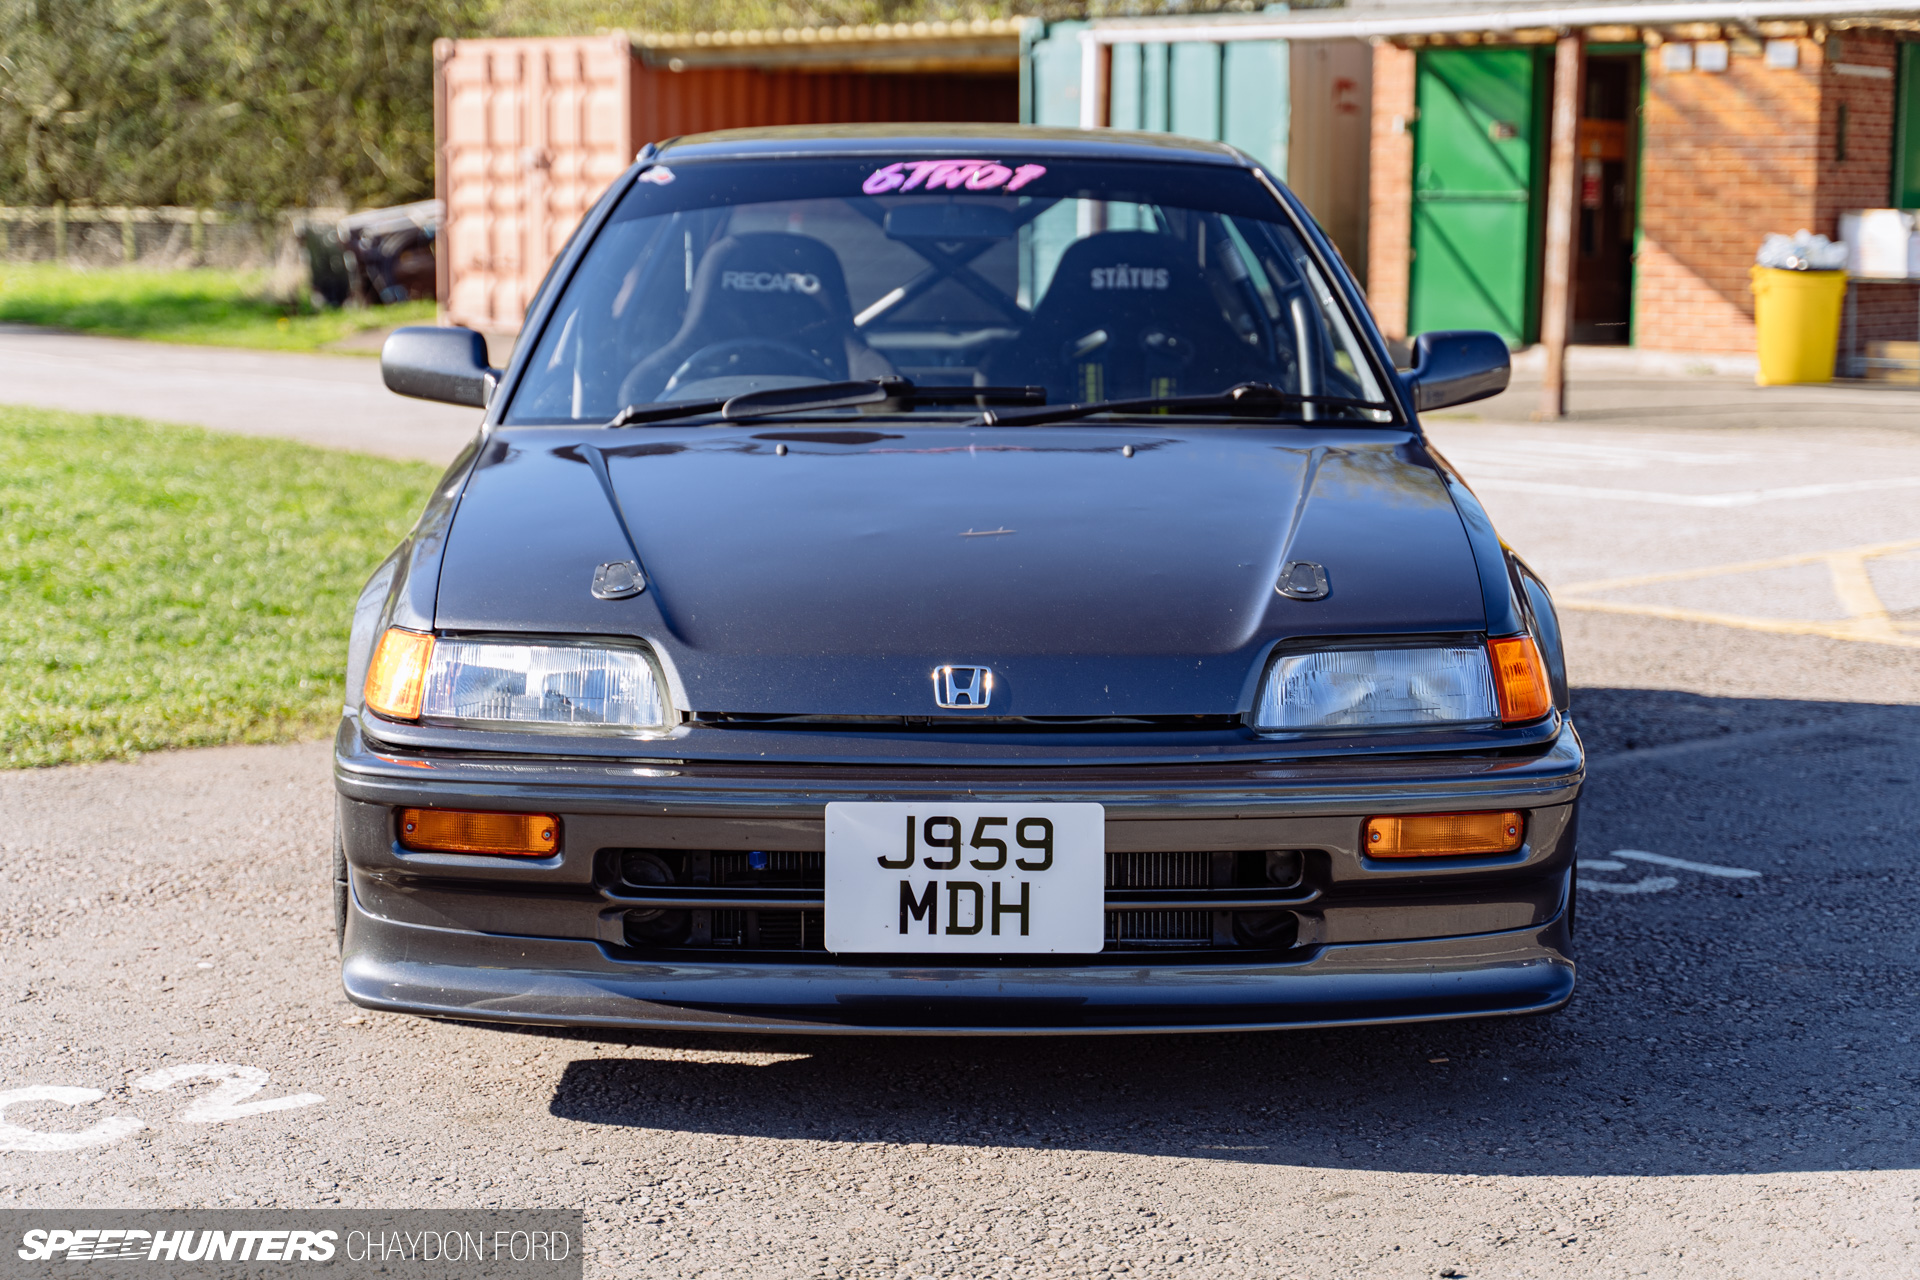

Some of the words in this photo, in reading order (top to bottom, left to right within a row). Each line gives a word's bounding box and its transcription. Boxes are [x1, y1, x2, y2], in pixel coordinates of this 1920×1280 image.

[722, 271, 820, 294] RECARO
[877, 815, 1054, 871] J959
[899, 880, 1030, 936] MDH
